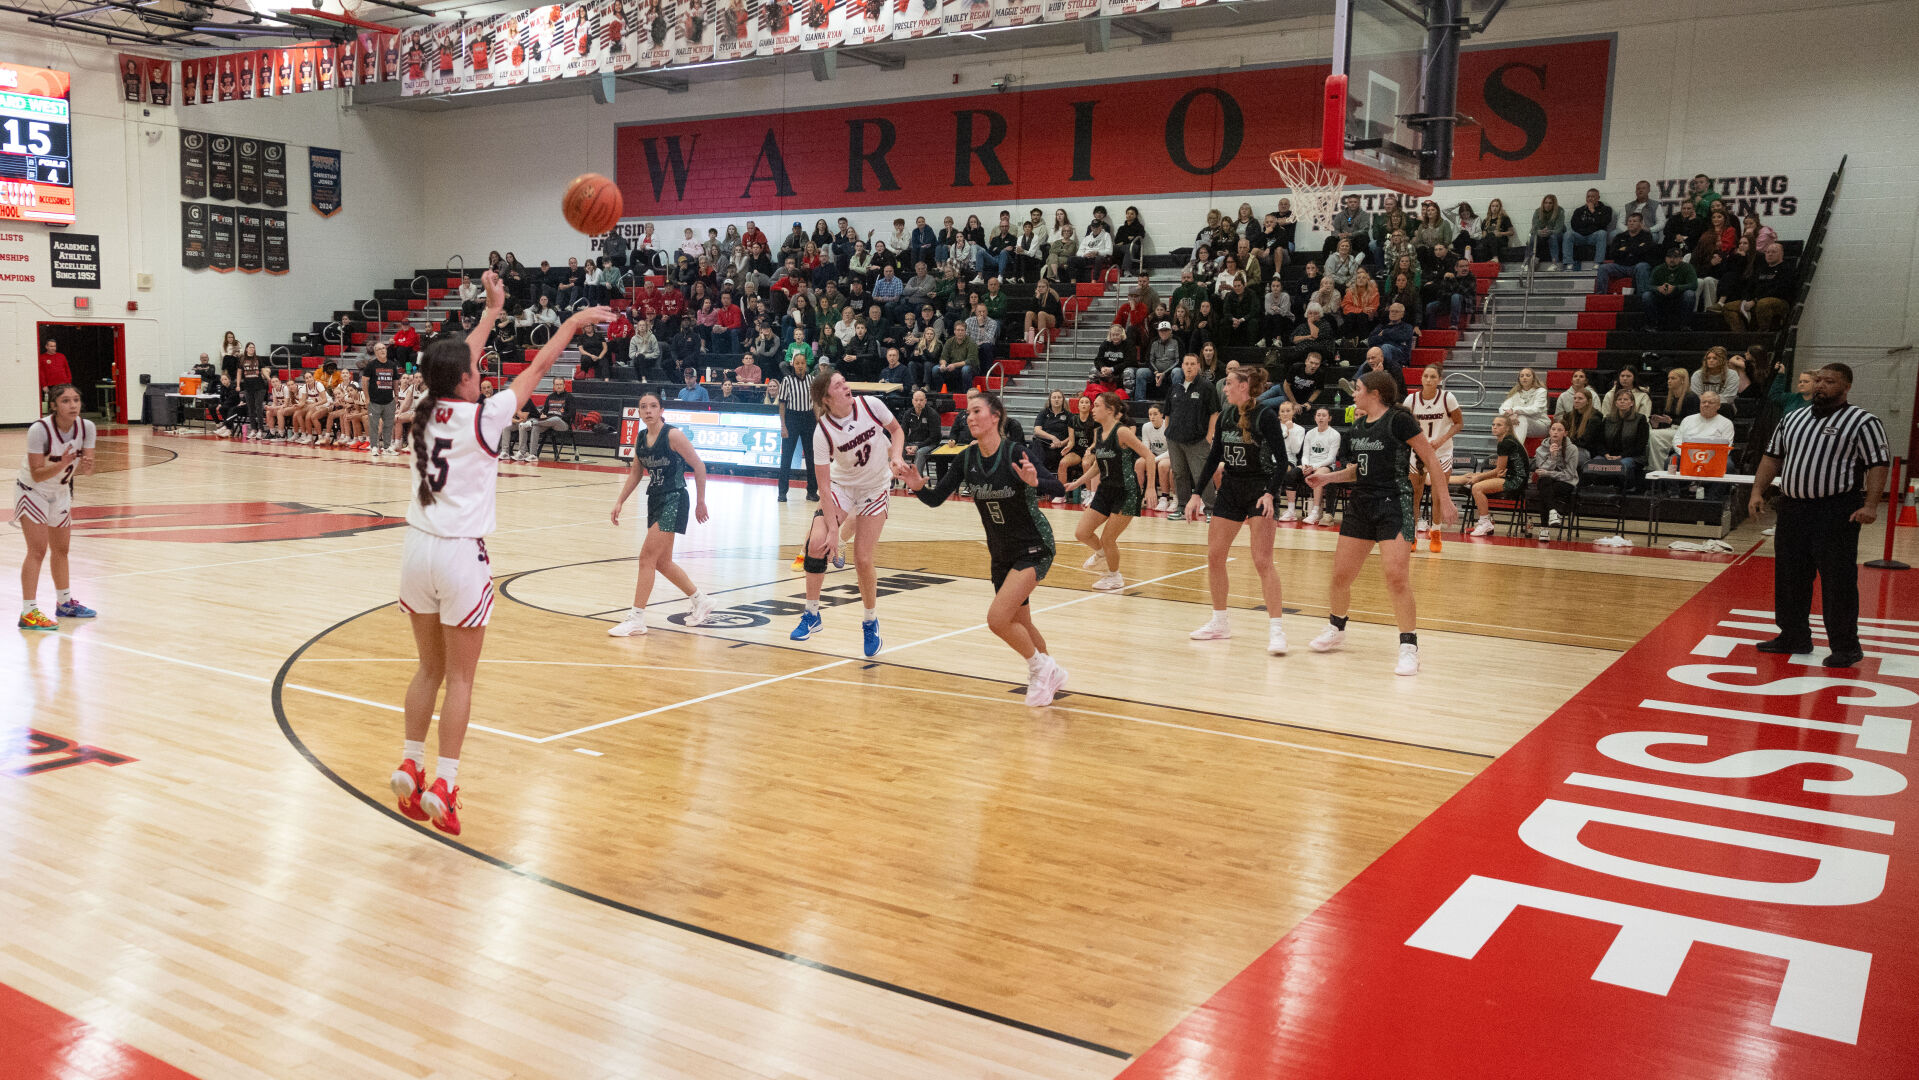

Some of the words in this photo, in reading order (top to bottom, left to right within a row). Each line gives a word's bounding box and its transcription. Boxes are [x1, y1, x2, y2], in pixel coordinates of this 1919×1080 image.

[827, 29, 843, 39] RYAN
[853, 27, 866, 35] ISLA
[868, 24, 885, 33] WEAR
[3, 119, 51, 155] 15
[639, 61, 1548, 203] WARRIOS
[47, 169, 59, 183] 4
[319, 202, 333, 210] 2024
[211, 214, 233, 224] PLYER
[240, 215, 260, 225] PLYER
[264, 218, 285, 228] PLYER
[58, 252, 92, 261] ATHLETIC
[54, 261, 97, 271] EXCELLENCE
[55, 271, 77, 280] SINCE
[77, 272, 96, 280] 1952
[751, 432, 778, 452] 15
[837, 426, 877, 453] WARRIORS
[1358, 453, 1369, 476] 3
[60, 464, 74, 485] 2
[986, 501, 1005, 525] 5
